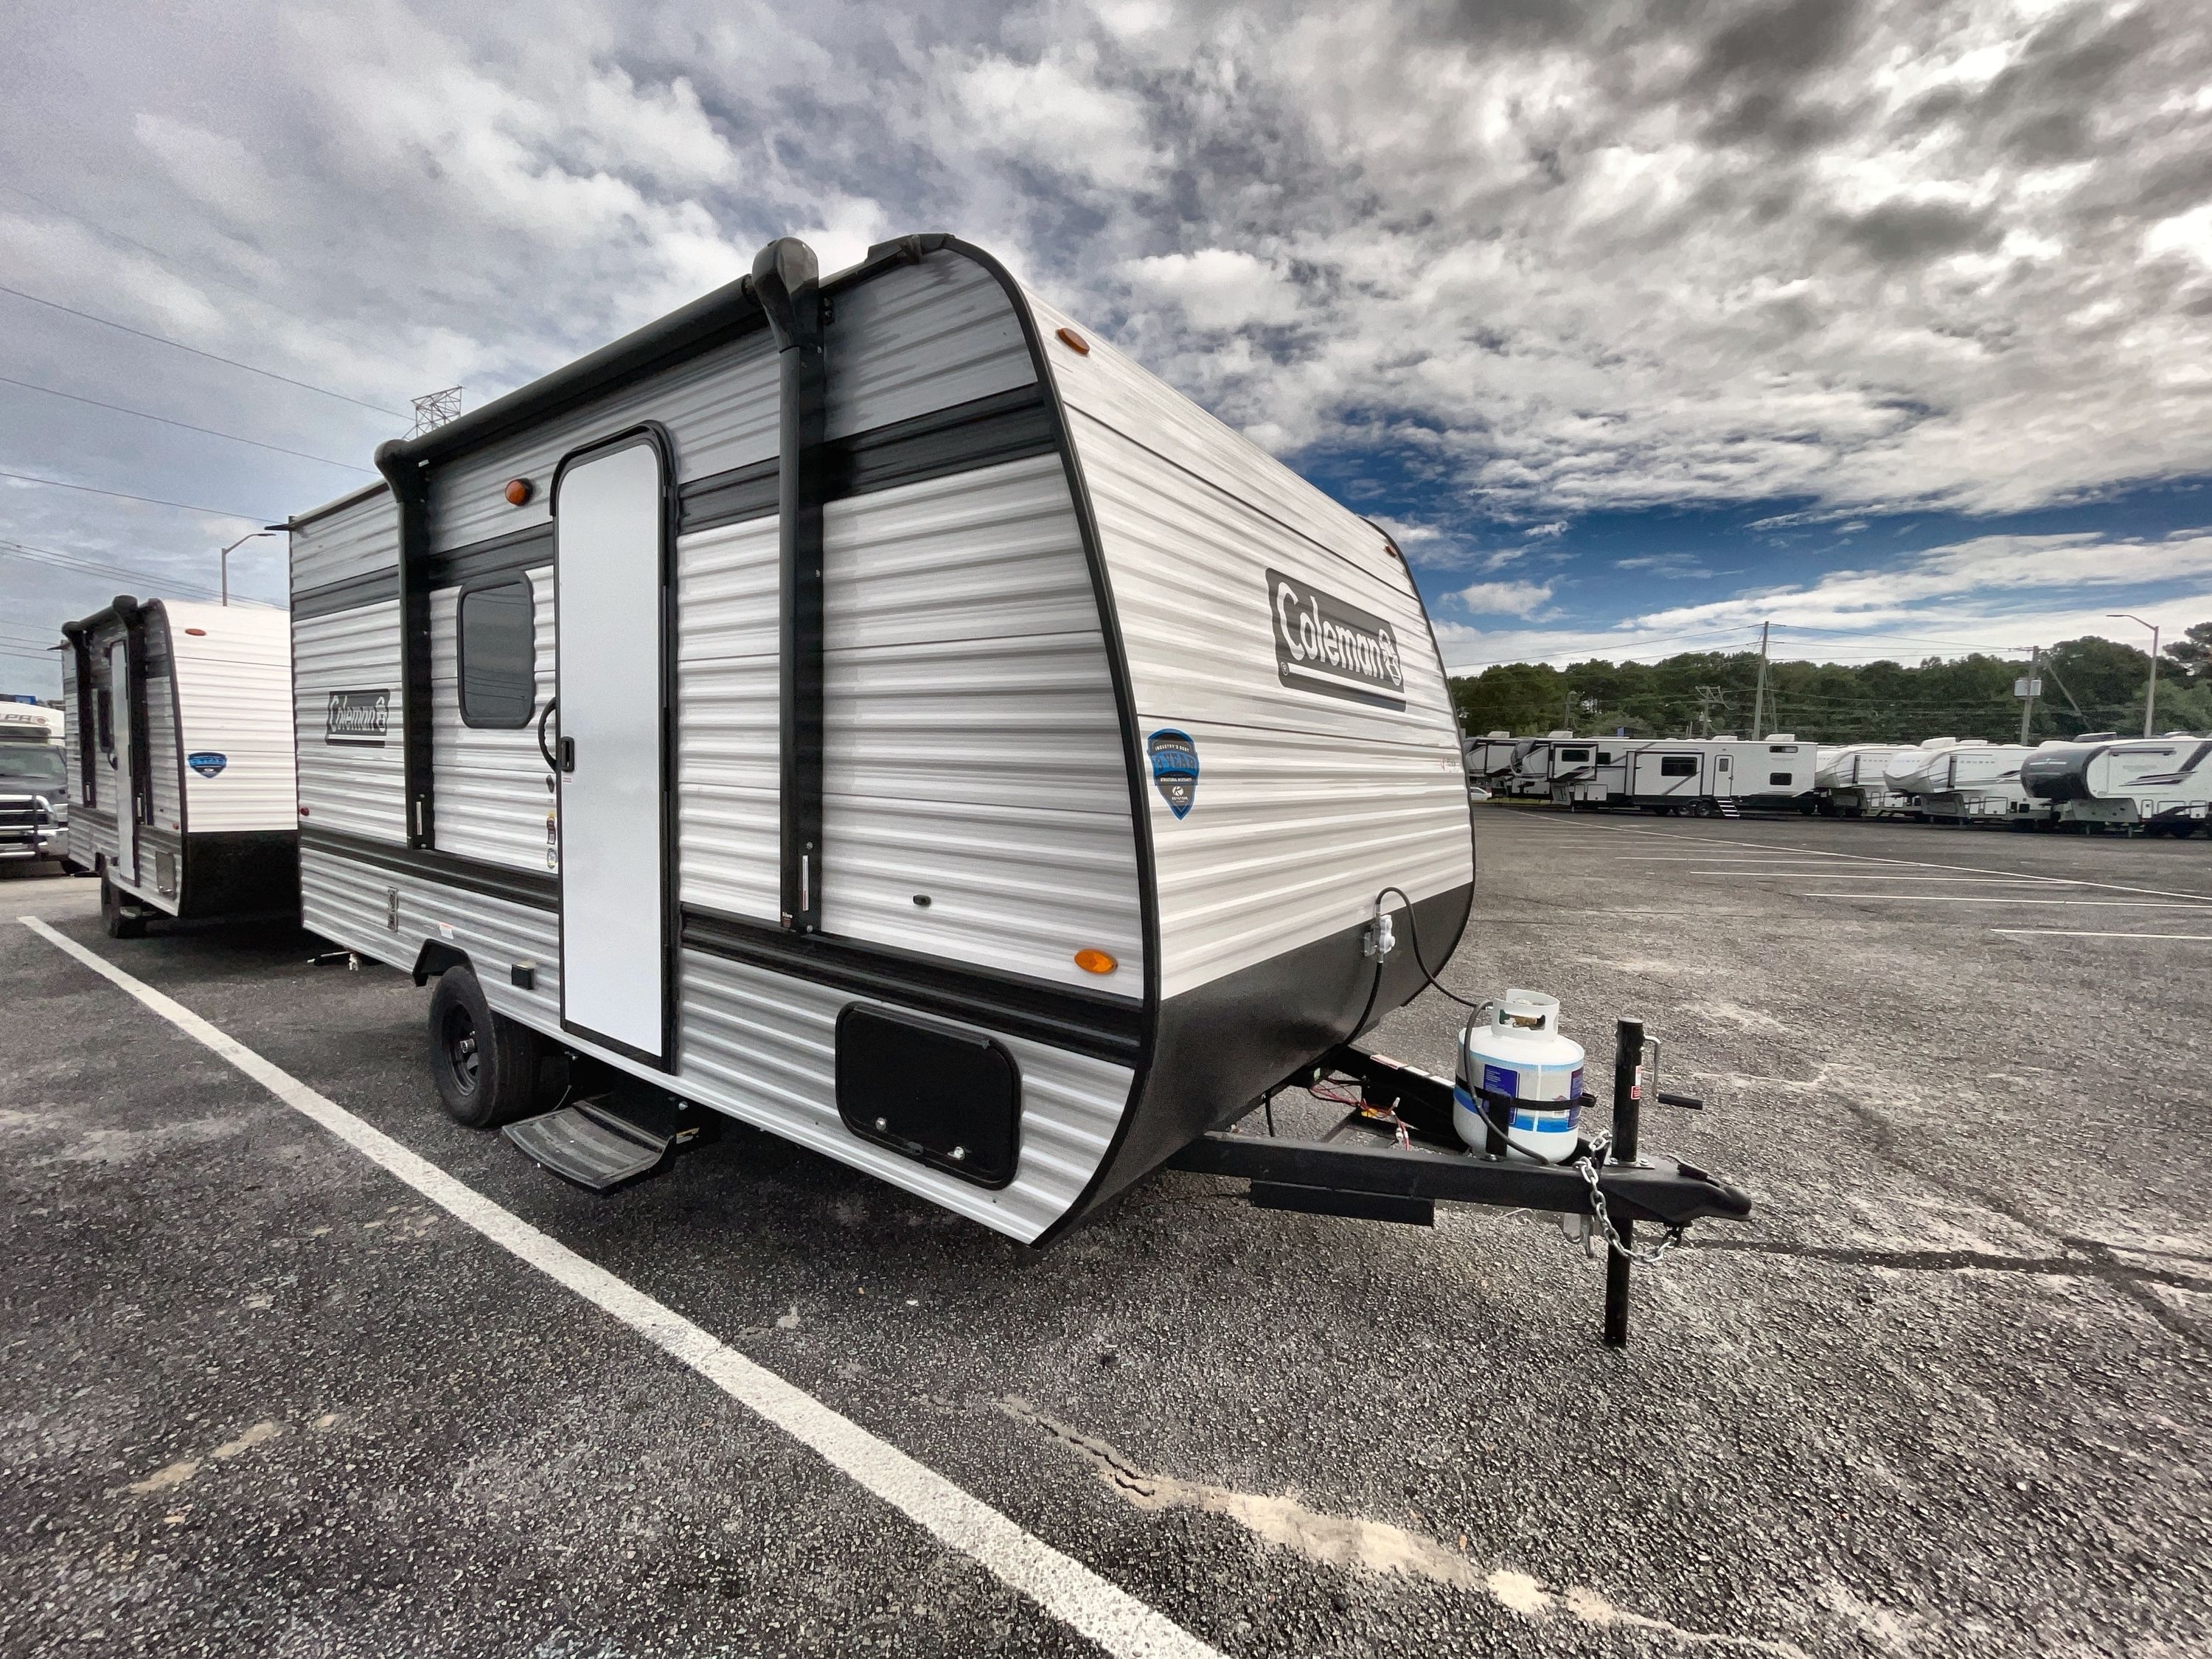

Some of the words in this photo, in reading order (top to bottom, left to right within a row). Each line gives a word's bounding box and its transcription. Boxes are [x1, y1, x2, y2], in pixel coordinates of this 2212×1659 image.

[1276, 582, 1384, 679] Coleman
[329, 695, 375, 732] Coleman
[1163, 752, 1197, 771] YEAR
